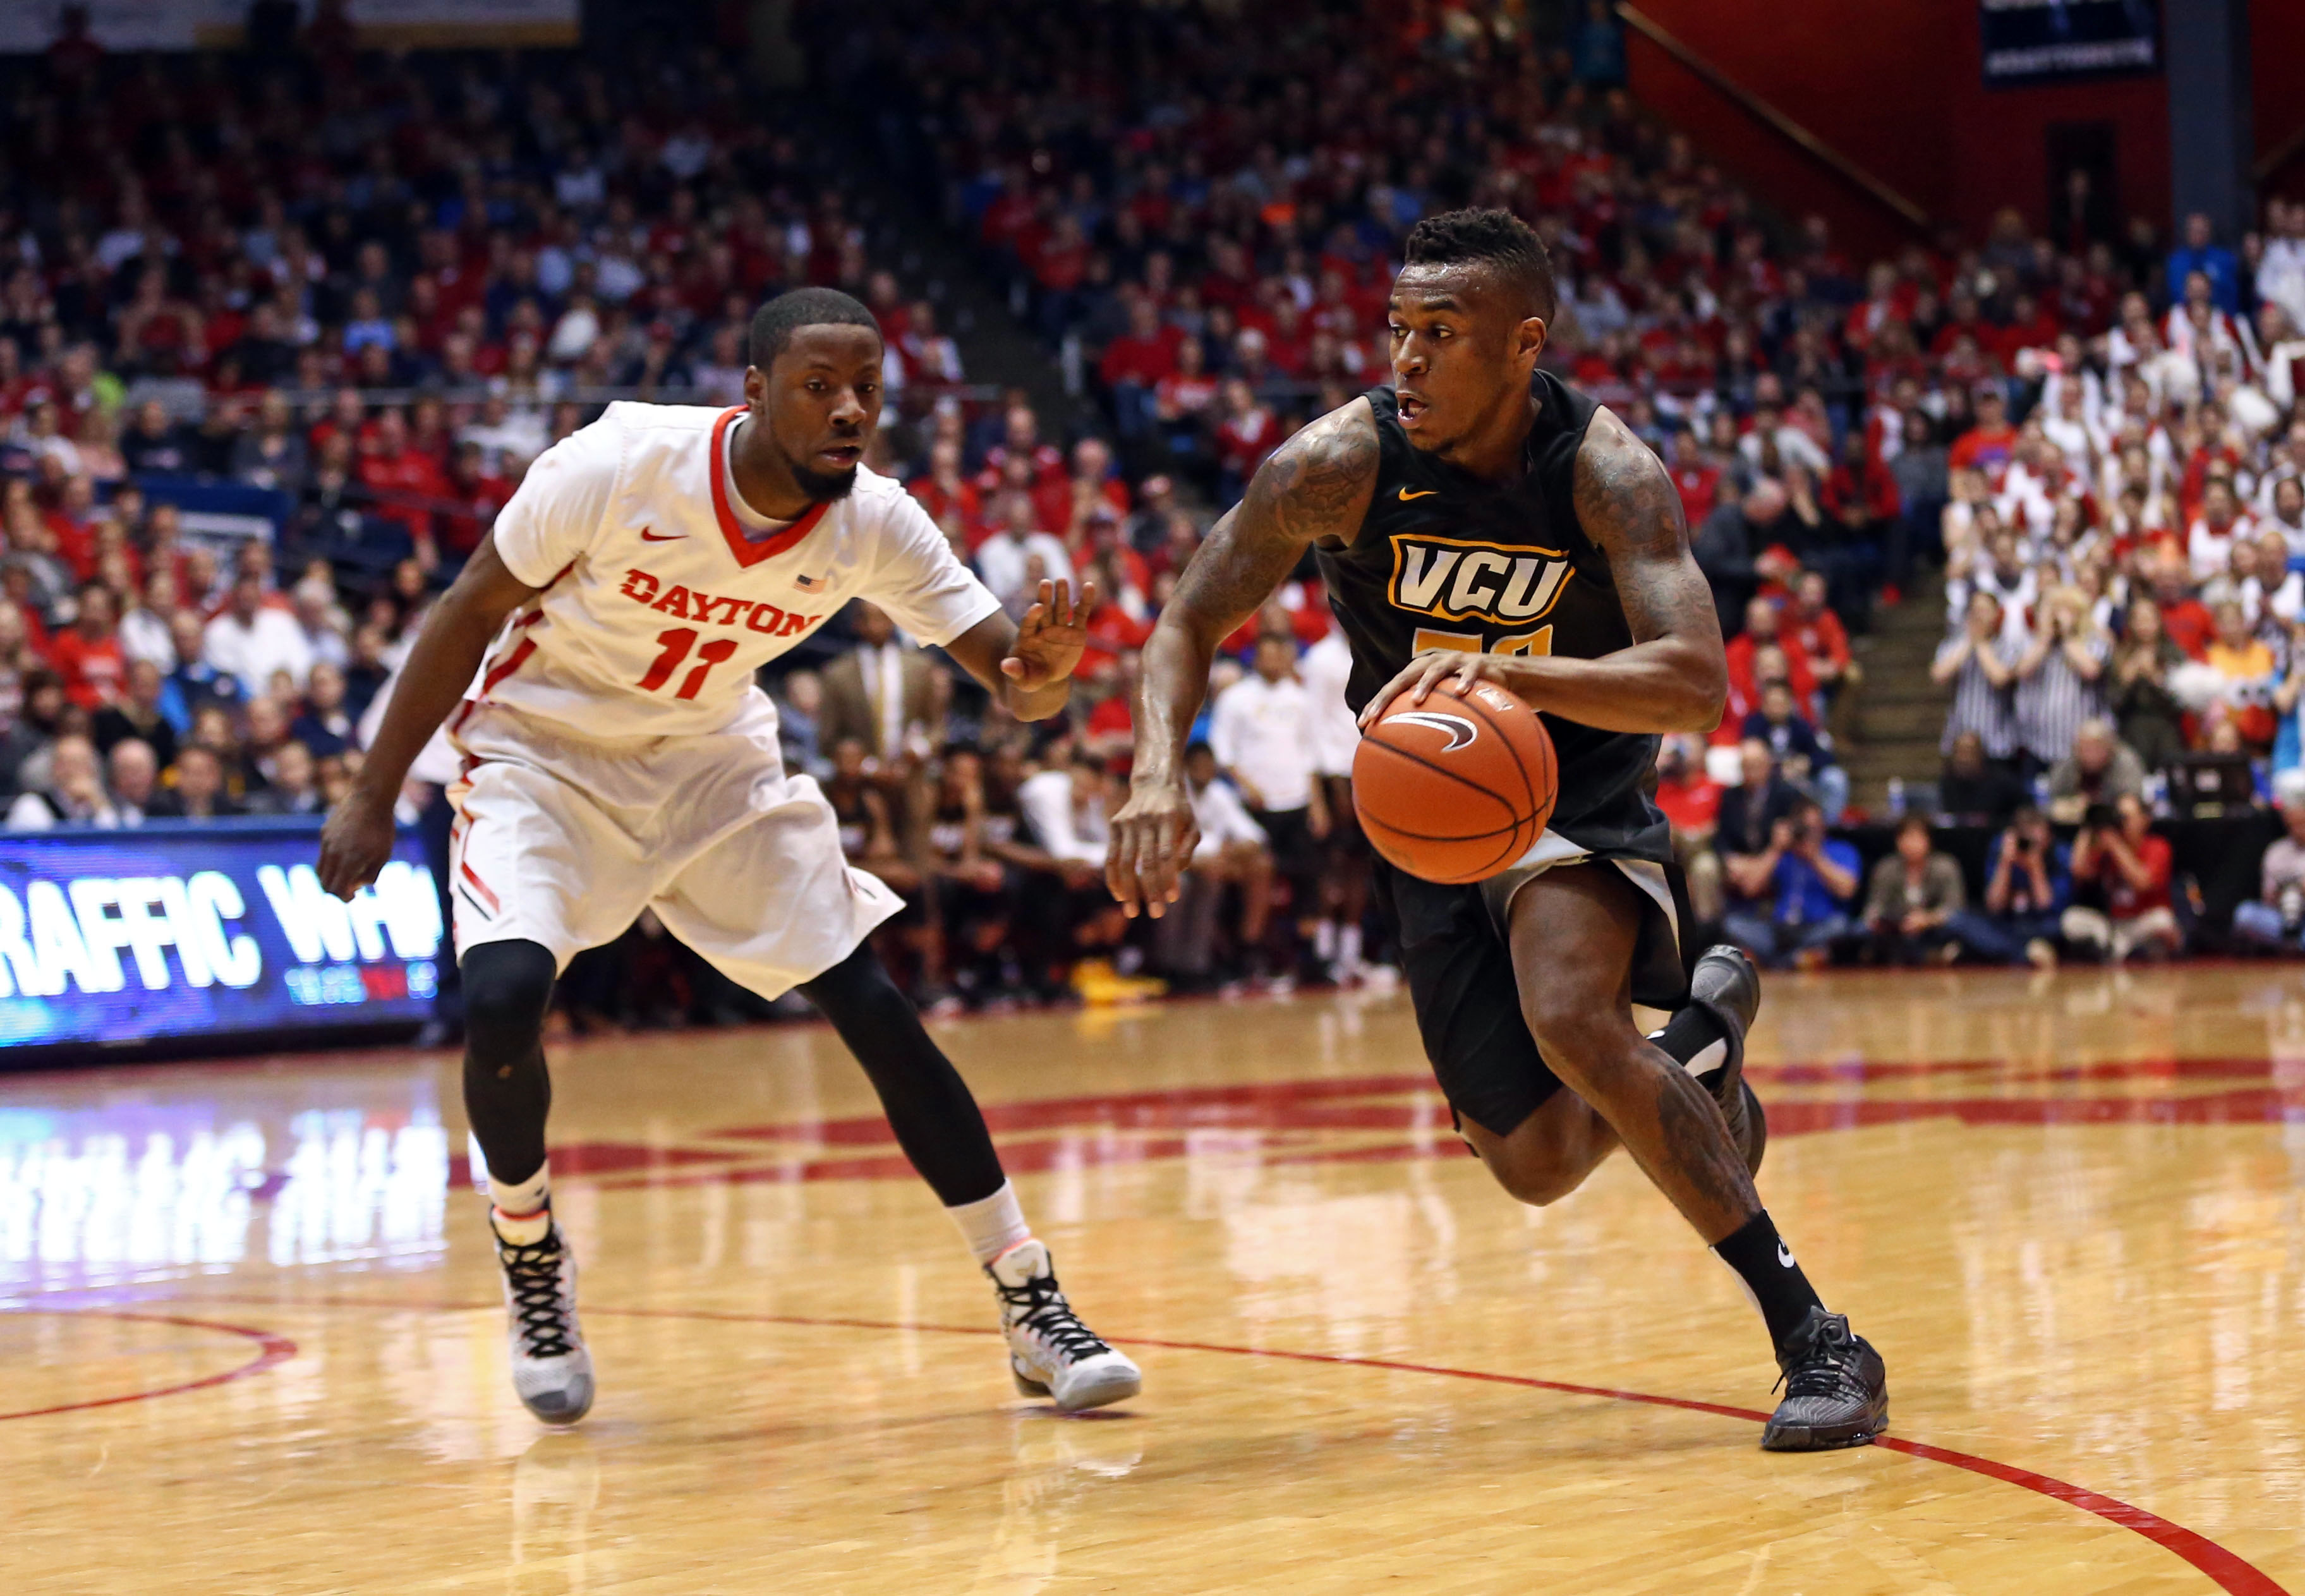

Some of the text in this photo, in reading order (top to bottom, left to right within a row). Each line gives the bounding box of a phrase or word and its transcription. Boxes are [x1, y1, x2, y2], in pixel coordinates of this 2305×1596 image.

[619, 568, 823, 637] DAYTON
[1400, 544, 1568, 617] VCU
[635, 627, 739, 701] 11
